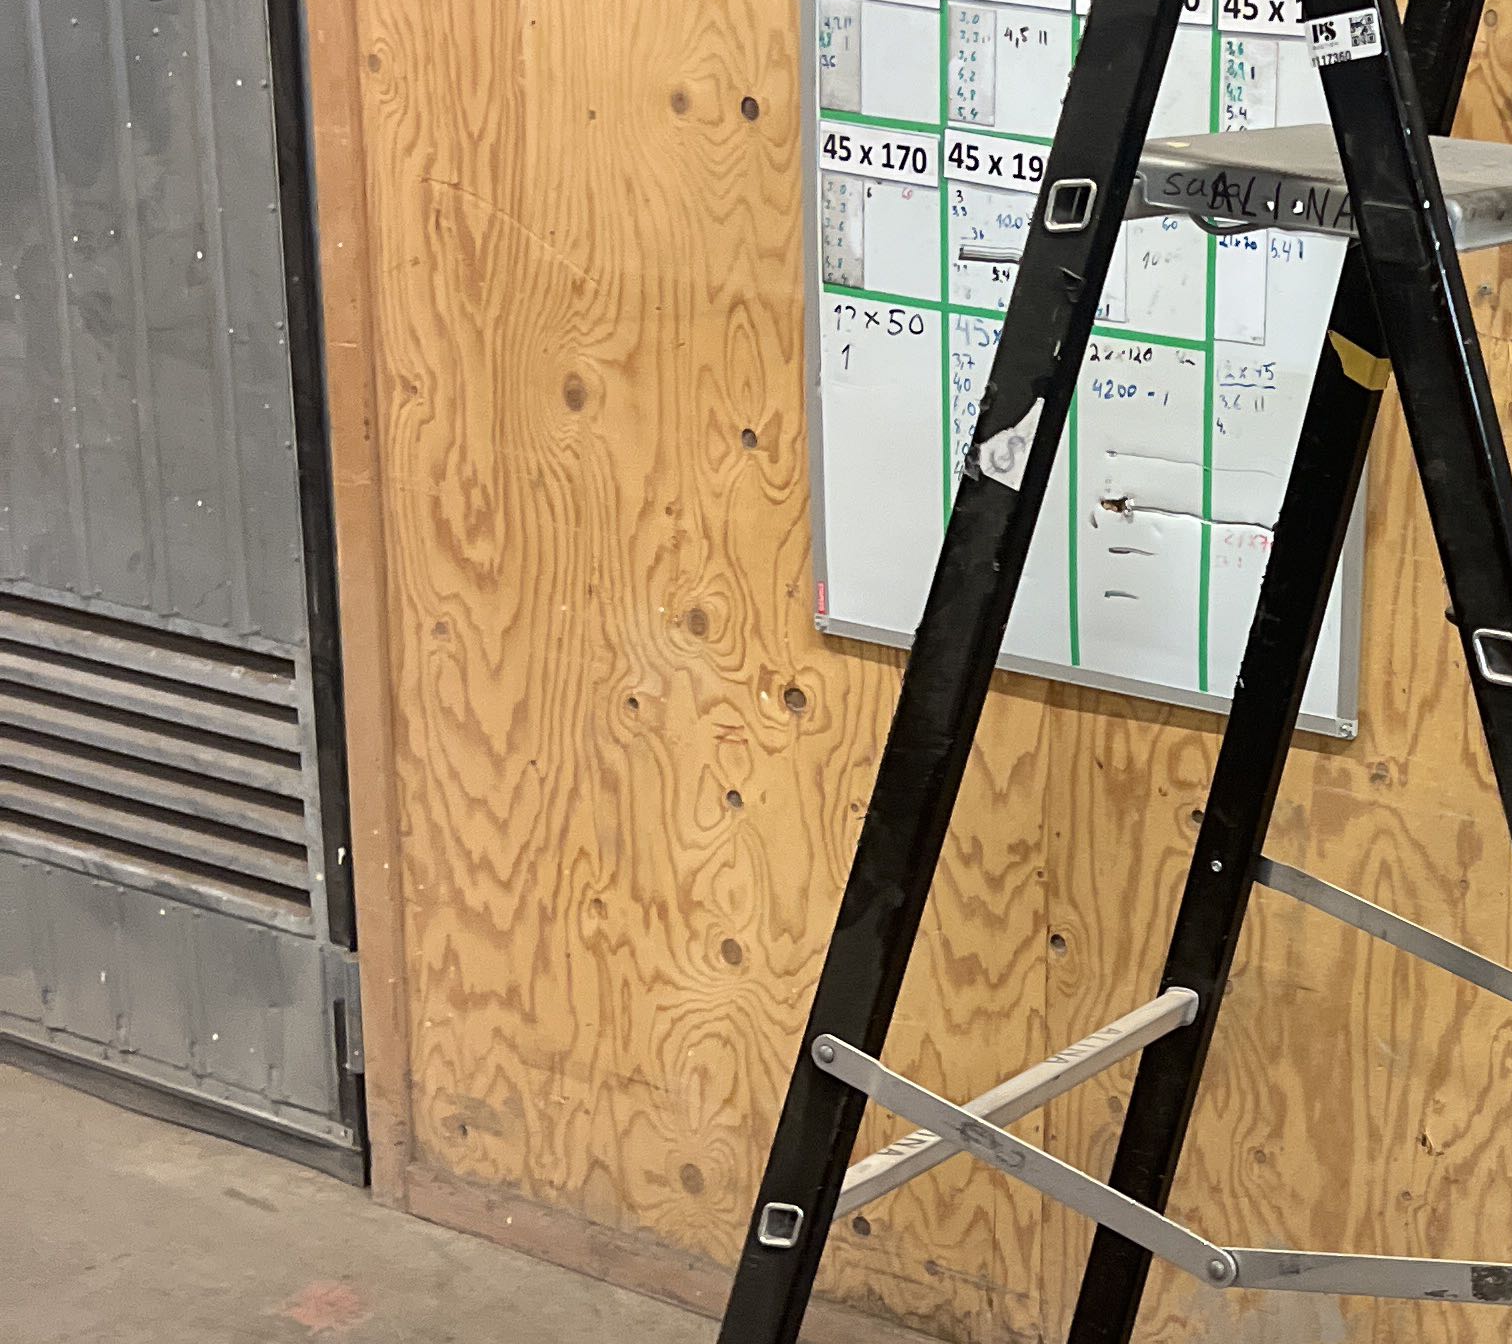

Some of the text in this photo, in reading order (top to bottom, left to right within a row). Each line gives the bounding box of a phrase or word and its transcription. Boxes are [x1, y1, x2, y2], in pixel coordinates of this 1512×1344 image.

[1268, 0, 1285, 23] x
[823, 134, 927, 174] 45 x 170
[949, 142, 980, 172] 45
[988, 154, 1003, 177] x
[887, 308, 924, 336] 50
